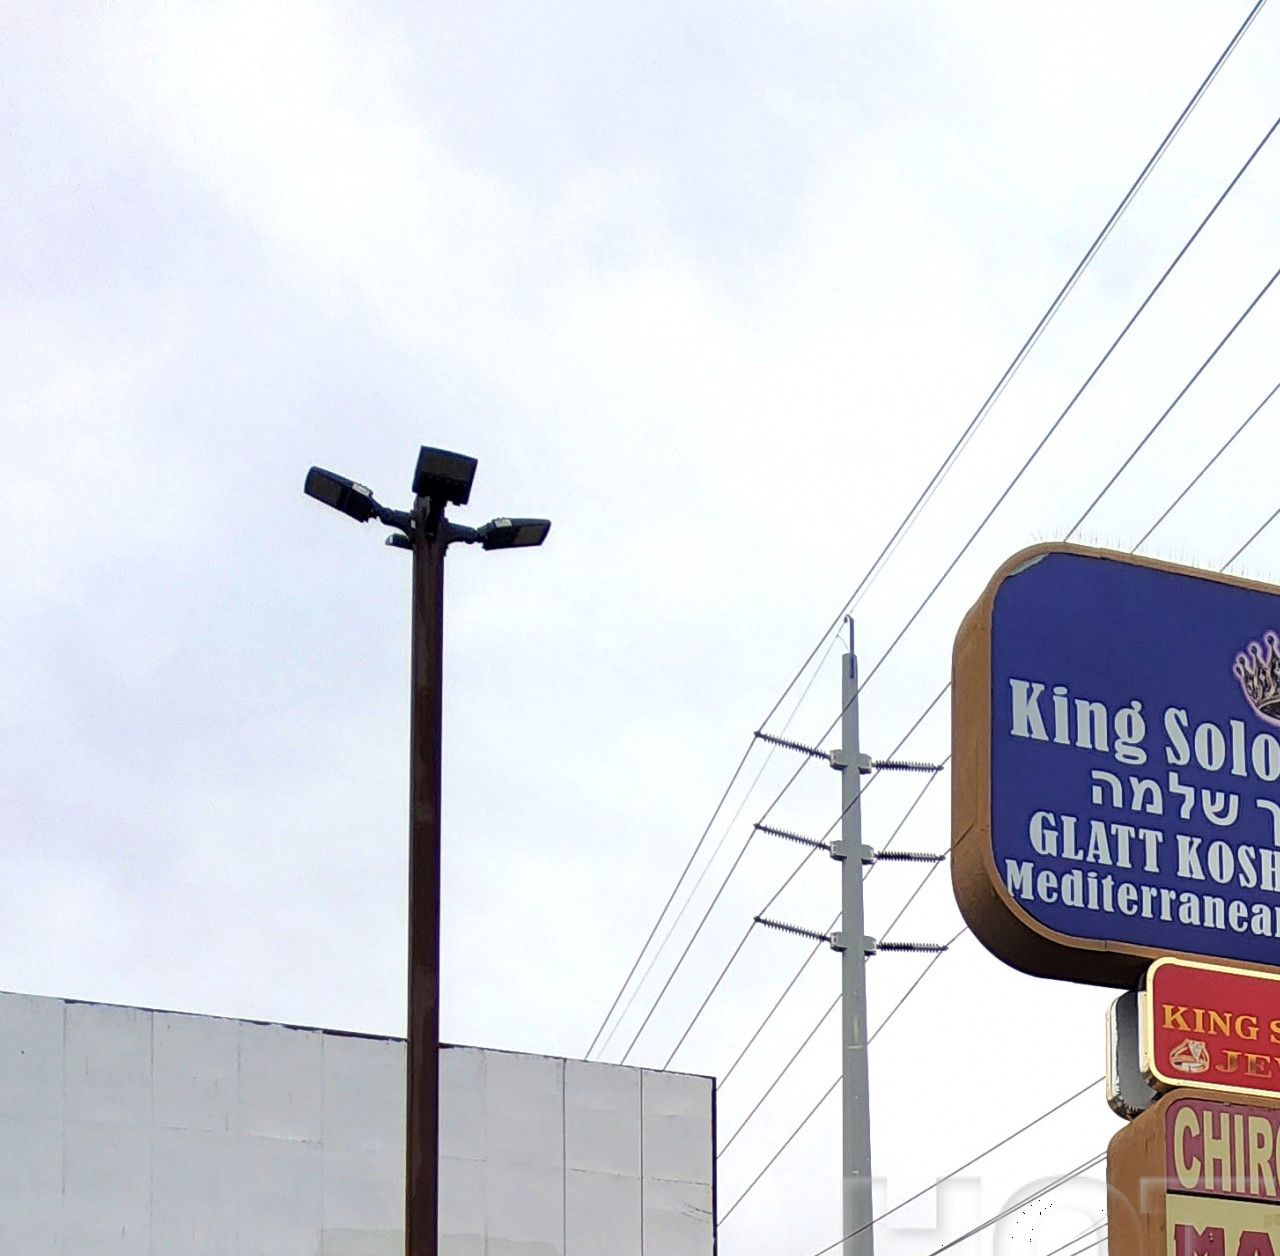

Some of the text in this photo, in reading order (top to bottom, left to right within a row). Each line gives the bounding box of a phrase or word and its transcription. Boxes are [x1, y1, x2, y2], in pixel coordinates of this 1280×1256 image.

[1010, 677, 1147, 764] King
[1091, 769, 1239, 826] שלמה
[1029, 810, 1163, 874] GLATT
[1161, 1003, 1259, 1041] KING
